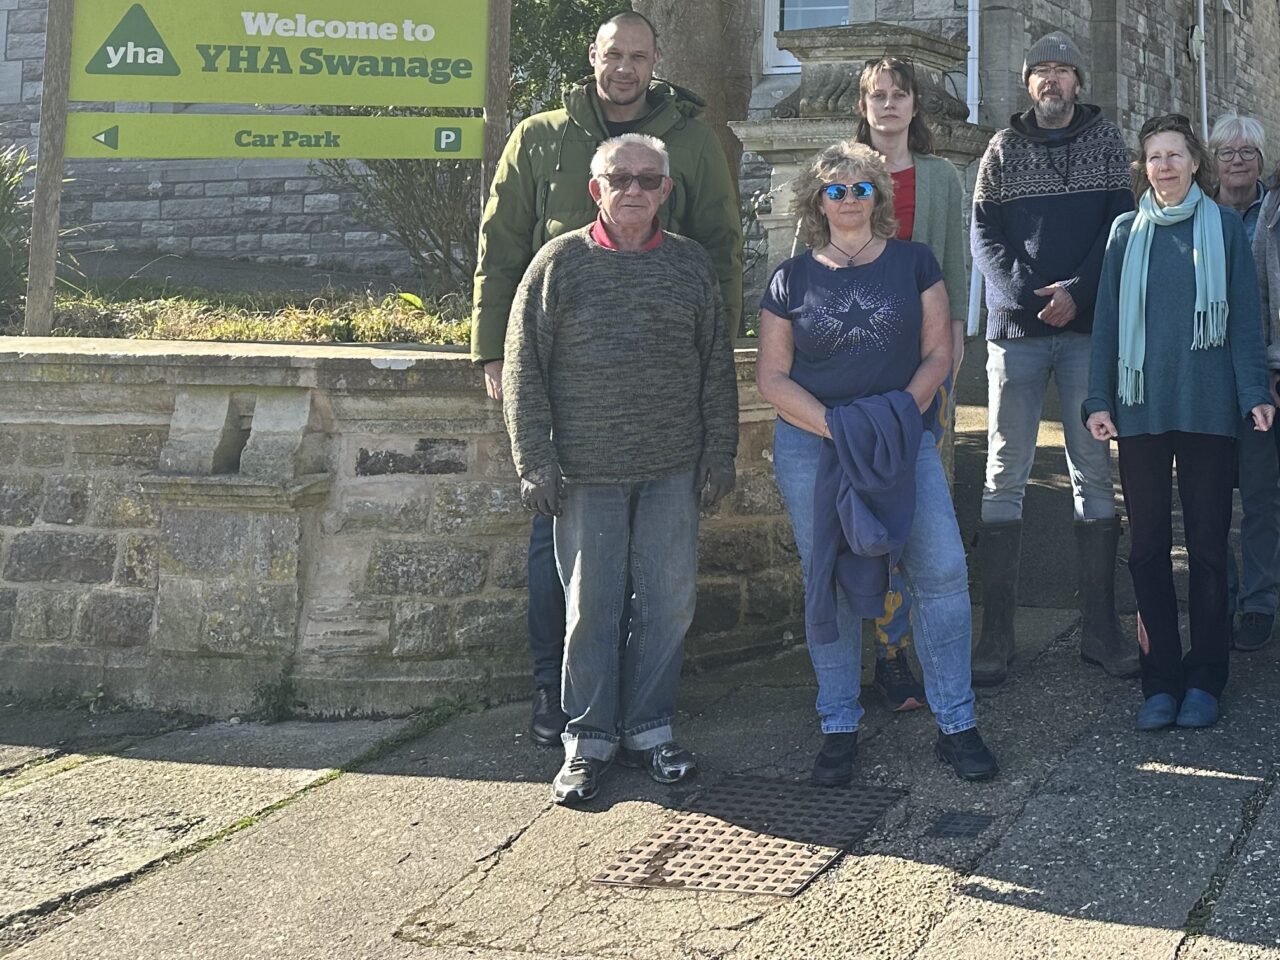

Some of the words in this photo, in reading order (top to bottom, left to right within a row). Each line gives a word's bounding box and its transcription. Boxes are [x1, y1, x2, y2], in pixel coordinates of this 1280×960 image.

[241, 11, 398, 40] Welcome
[402, 19, 436, 42] to
[105, 42, 164, 69] yha
[196, 44, 293, 74] YHA
[299, 47, 473, 85] Swanage
[234, 130, 278, 148] Car
[282, 130, 341, 148] Park
[440, 130, 456, 149] P
